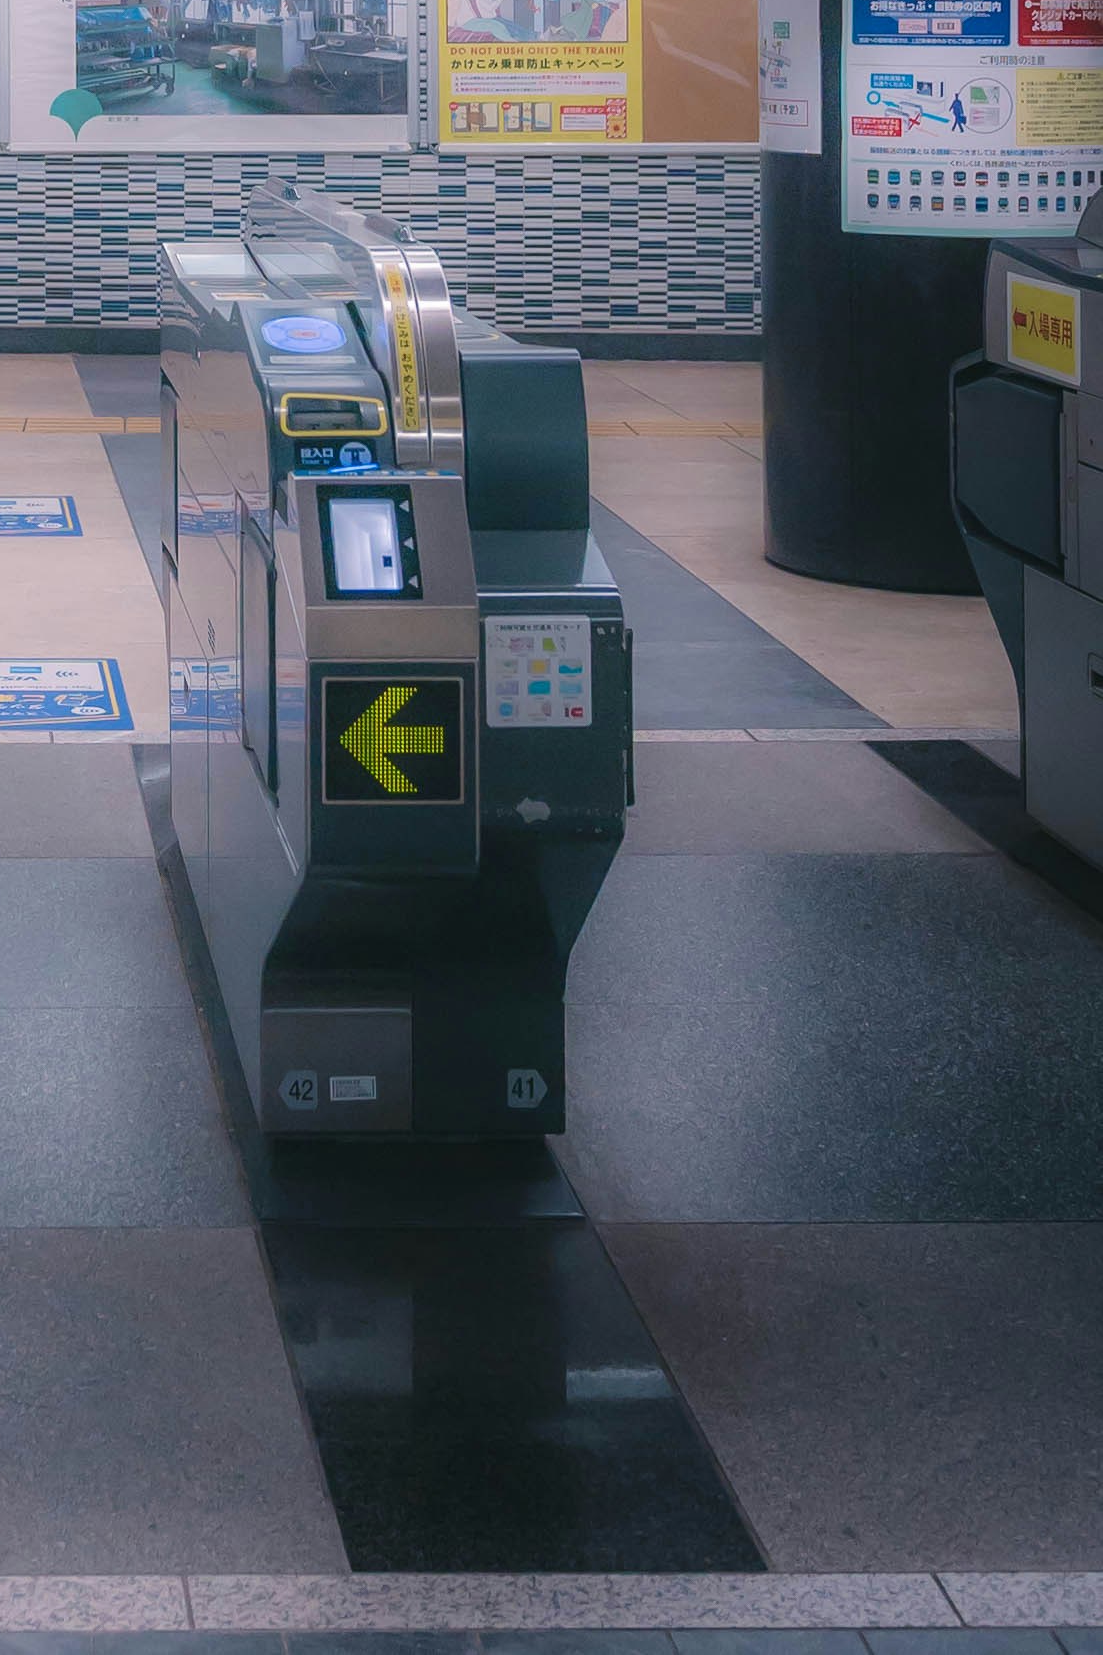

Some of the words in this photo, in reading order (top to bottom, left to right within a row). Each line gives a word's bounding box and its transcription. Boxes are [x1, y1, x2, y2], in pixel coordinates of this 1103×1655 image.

[450, 47, 466, 55] DO
[470, 47, 493, 55] NOT
[496, 47, 524, 55] RUSH
[528, 47, 559, 55] ONTO
[563, 47, 582, 55] THE
[451, 58, 625, 70] かけこみ乗車防止キャンペーン
[1028, 311, 1073, 349] 入場専用
[288, 1079, 314, 1101] 42
[511, 1077, 536, 1100] 41
